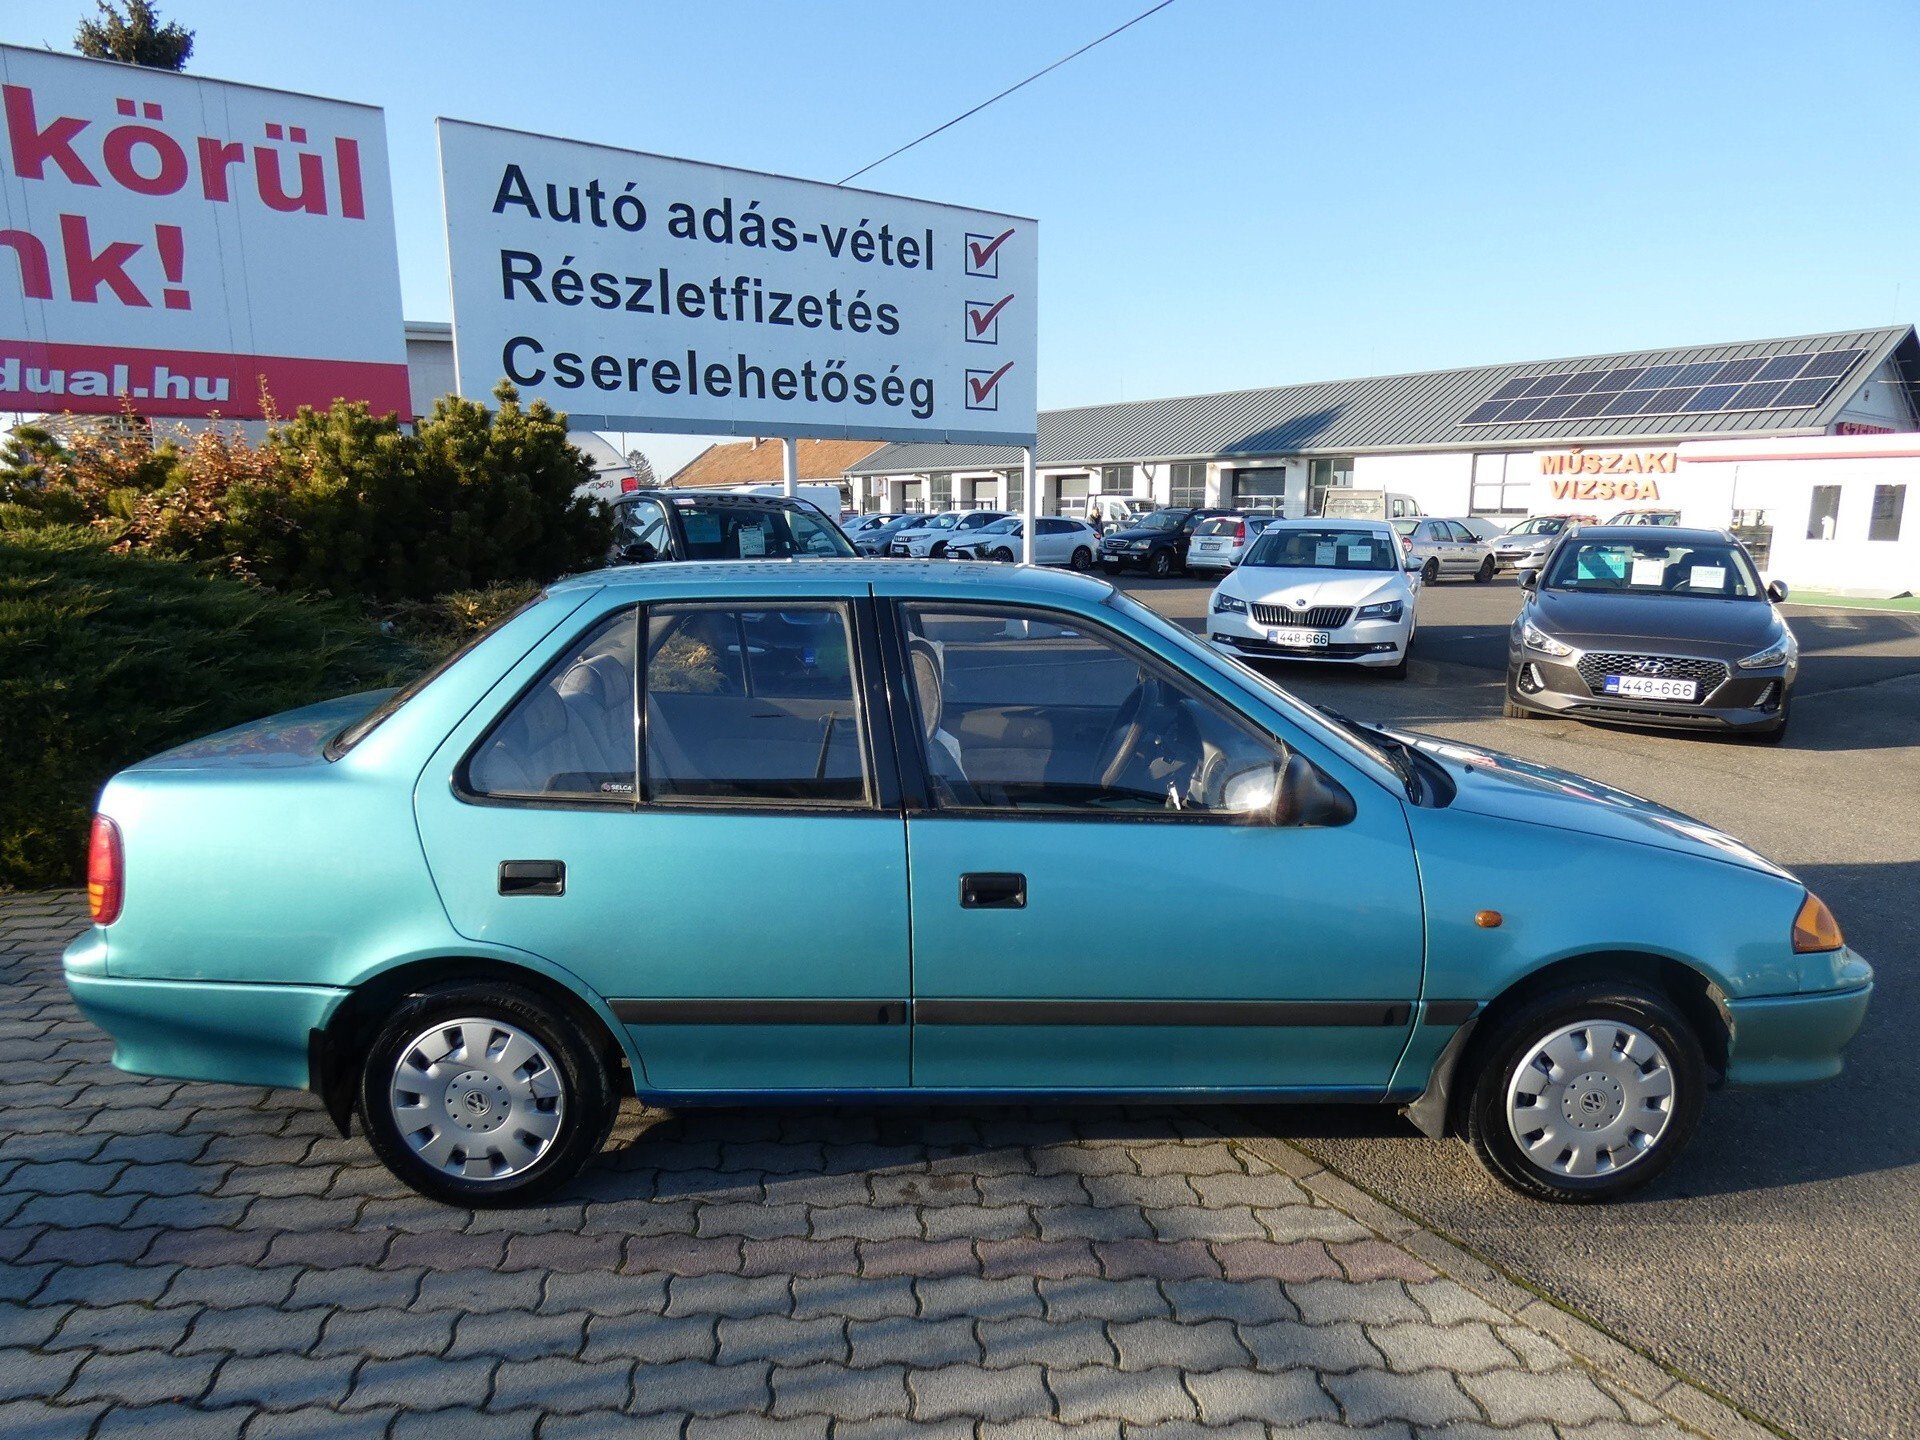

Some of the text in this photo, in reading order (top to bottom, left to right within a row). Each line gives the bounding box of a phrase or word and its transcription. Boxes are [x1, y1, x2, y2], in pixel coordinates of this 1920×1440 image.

[2, 84, 365, 220] körül
[492, 163, 934, 272] Autó adás-vétel
[500, 249, 900, 337] Részletfizetés
[502, 336, 934, 420] Cserelehetőség
[1541, 446, 1677, 475] MŰSZAKI
[1279, 632, 1327, 645] 448-666
[1622, 679, 1692, 696] 448-666
